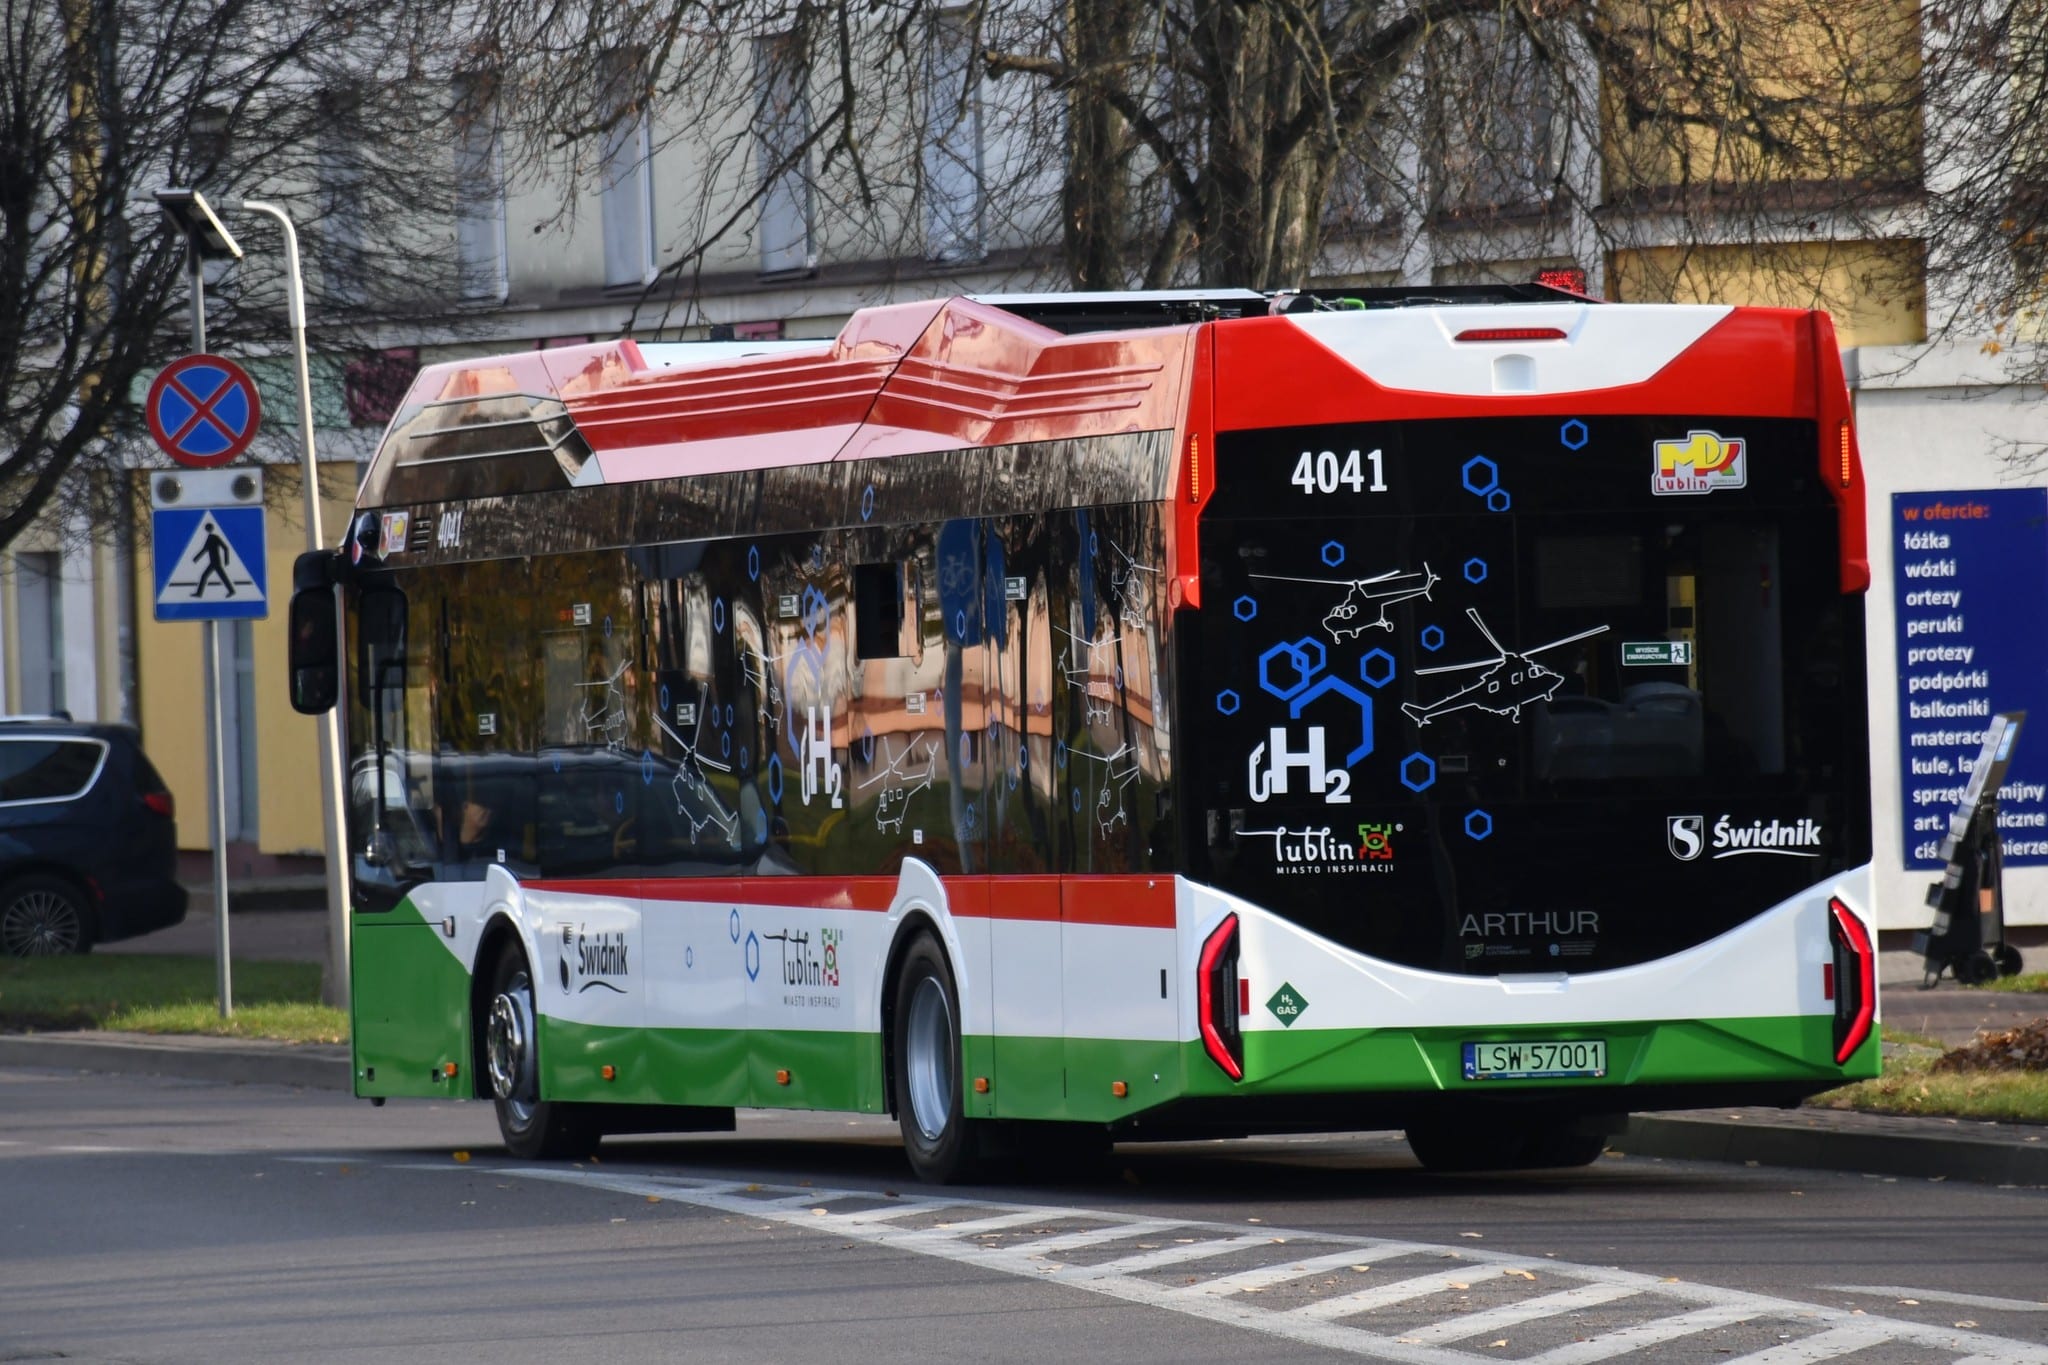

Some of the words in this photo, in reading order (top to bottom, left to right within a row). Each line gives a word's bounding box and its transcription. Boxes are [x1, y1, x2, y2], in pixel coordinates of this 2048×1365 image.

[1291, 449, 1388, 494] 4041
[1657, 477, 1708, 491] Lublin
[1903, 507, 1919, 520] w
[1923, 501, 1990, 519] ofercie:
[437, 511, 463, 548] 4041
[1903, 531, 1951, 550] łóżka
[1904, 558, 1957, 578] wózki
[1905, 588, 1962, 608] ortezy
[1907, 614, 1964, 638] peruki
[1908, 645, 1974, 666] protezy
[1909, 671, 1989, 694] podpórki
[1909, 698, 1990, 719] balkoniki
[1911, 756, 1956, 776] kule,
[1912, 786, 1966, 806] sprzęt
[1712, 814, 1822, 848] Świdnik
[1914, 815, 1945, 831] art.
[1276, 866, 1321, 875] MIASTO
[1327, 864, 1394, 874] INSPIRACJI
[1459, 911, 1599, 937] ARTHUR
[578, 922, 628, 976] Świdnik
[1276, 1006, 1298, 1015] GAS
[1478, 1045, 1522, 1071] LSW
[1531, 1044, 1599, 1070] 57001
